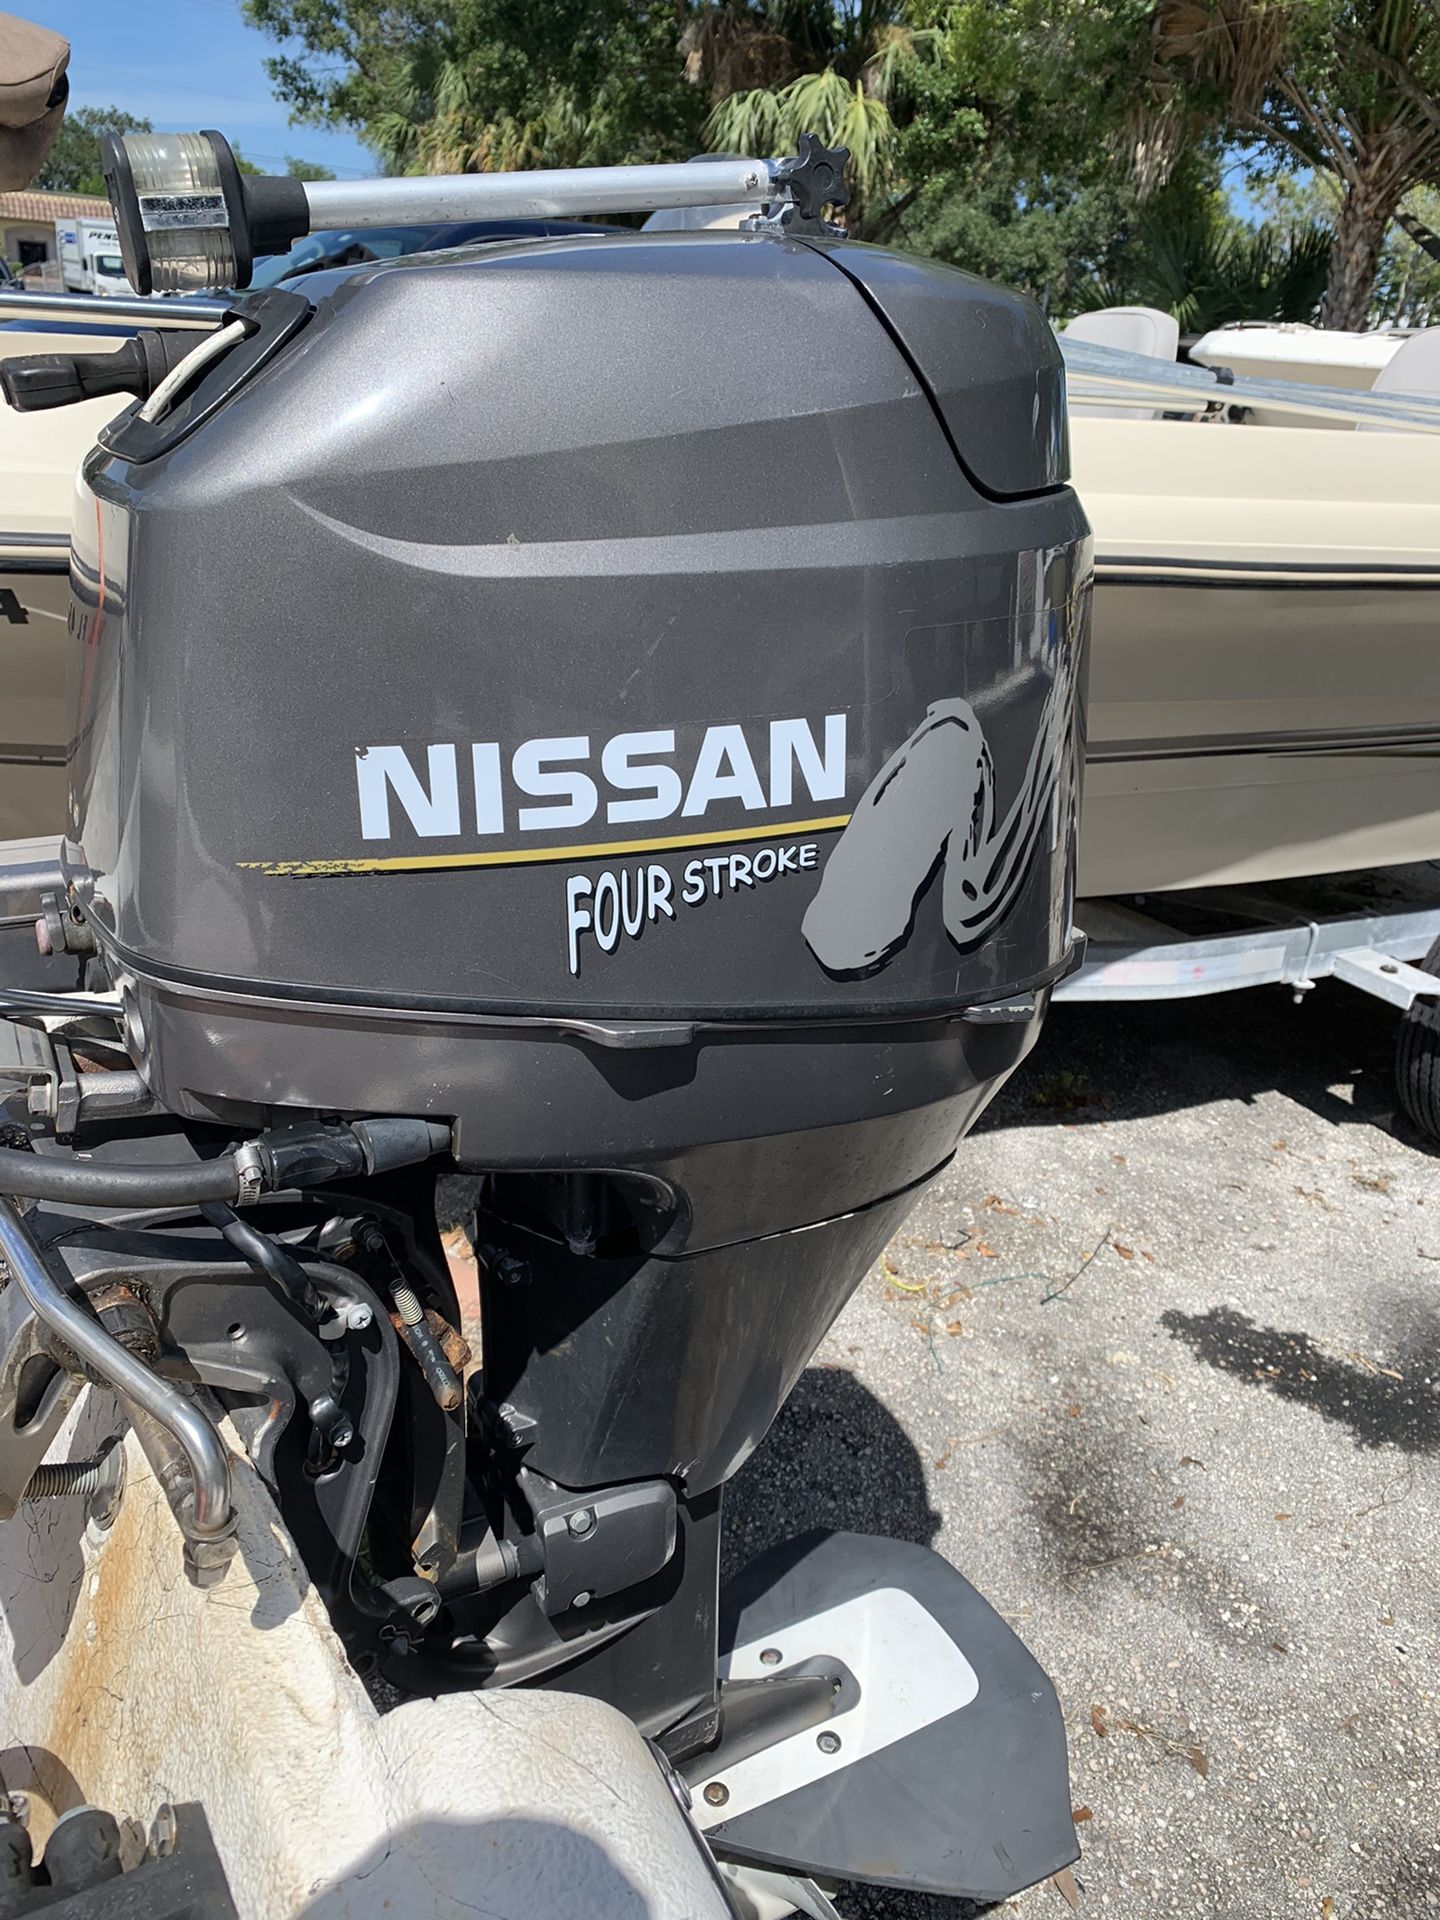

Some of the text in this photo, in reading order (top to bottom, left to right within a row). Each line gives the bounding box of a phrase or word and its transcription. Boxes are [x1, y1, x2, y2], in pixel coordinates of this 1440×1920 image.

[355, 713, 848, 840] NISSAN
[566, 842, 819, 976] FOUR STROKE
